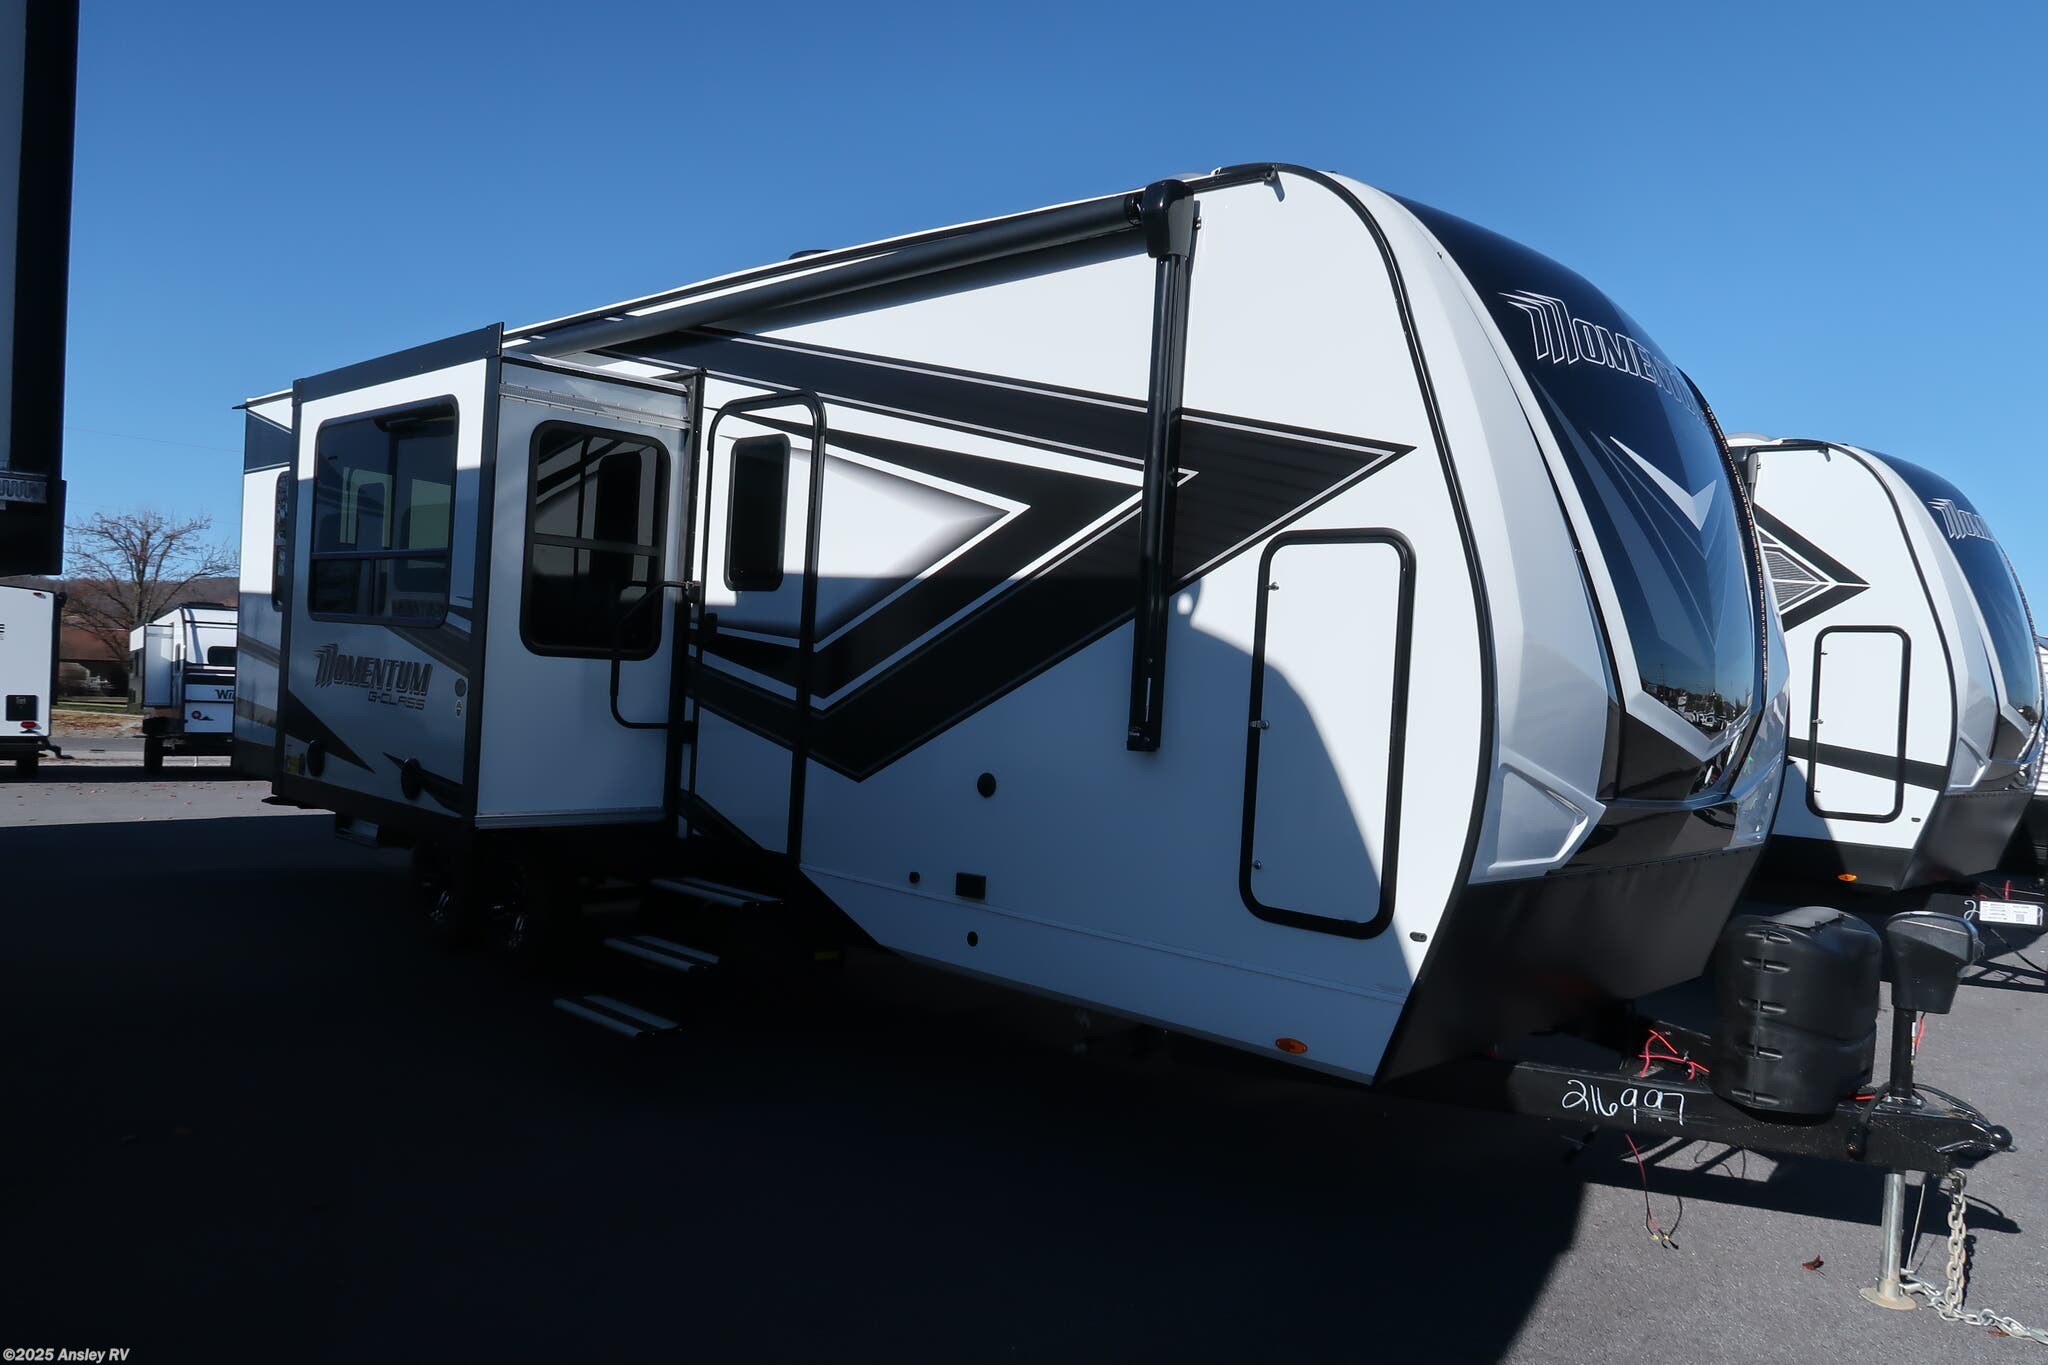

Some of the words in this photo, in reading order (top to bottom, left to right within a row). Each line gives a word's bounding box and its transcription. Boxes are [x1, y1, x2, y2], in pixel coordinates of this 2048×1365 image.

[312, 642, 433, 696] MOMENTUM
[368, 691, 425, 711] G-CLASS
[1562, 1079, 1684, 1126] 216997
